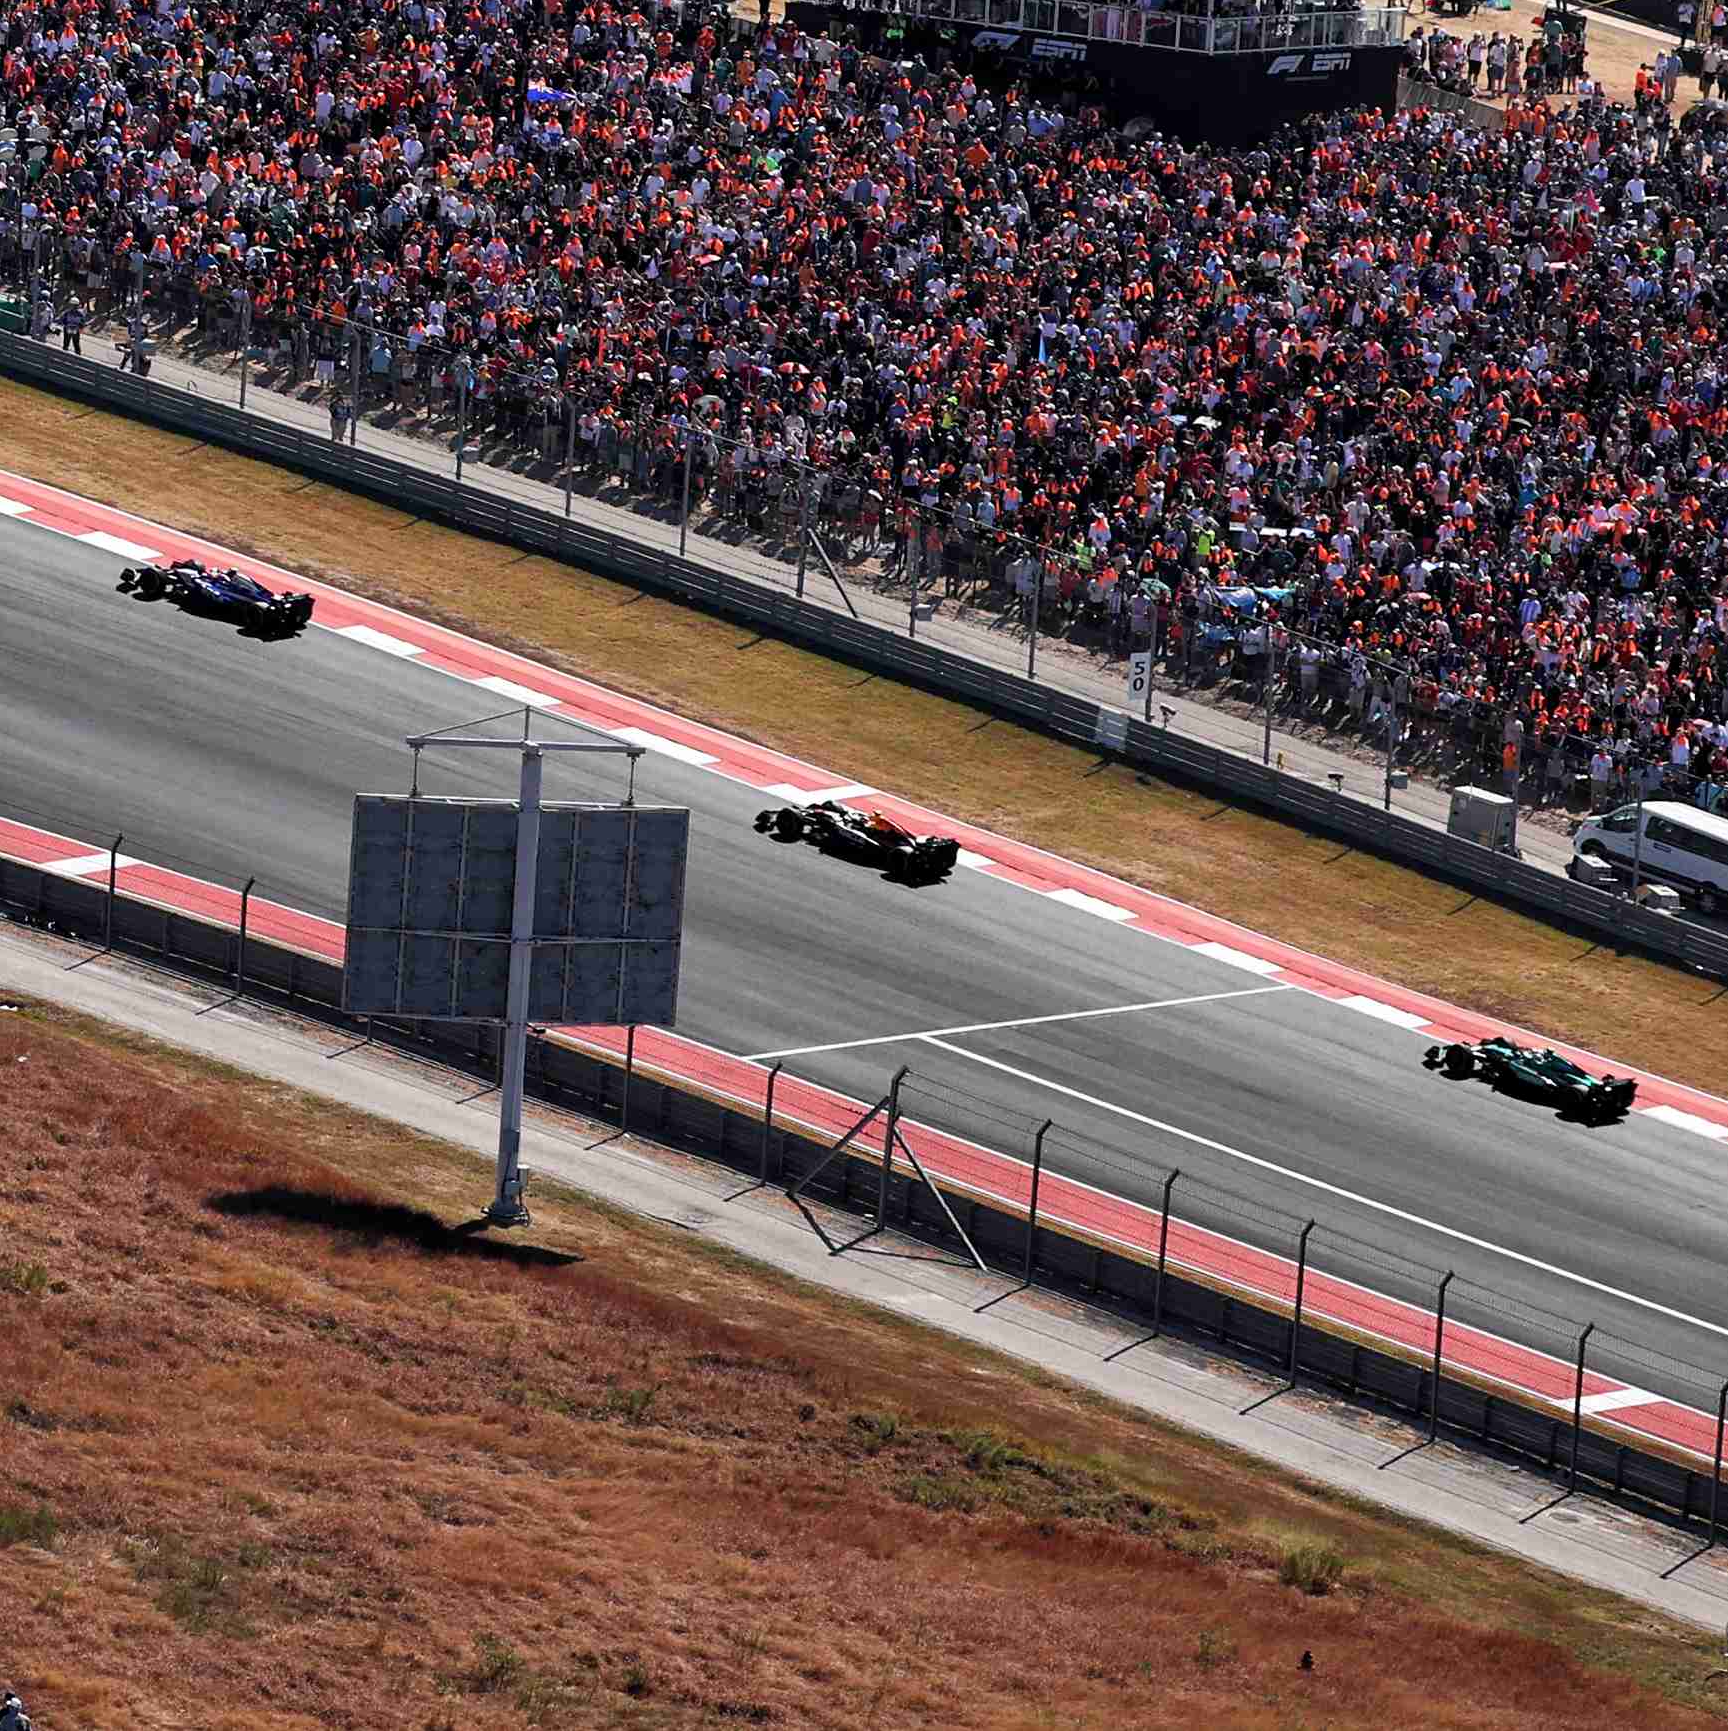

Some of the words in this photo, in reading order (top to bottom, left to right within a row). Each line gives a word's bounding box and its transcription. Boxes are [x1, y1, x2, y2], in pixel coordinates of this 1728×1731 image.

[1031, 37, 1088, 62] ESPN
[1312, 52, 1352, 71] ESPN
[1132, 661, 1147, 693] 50
